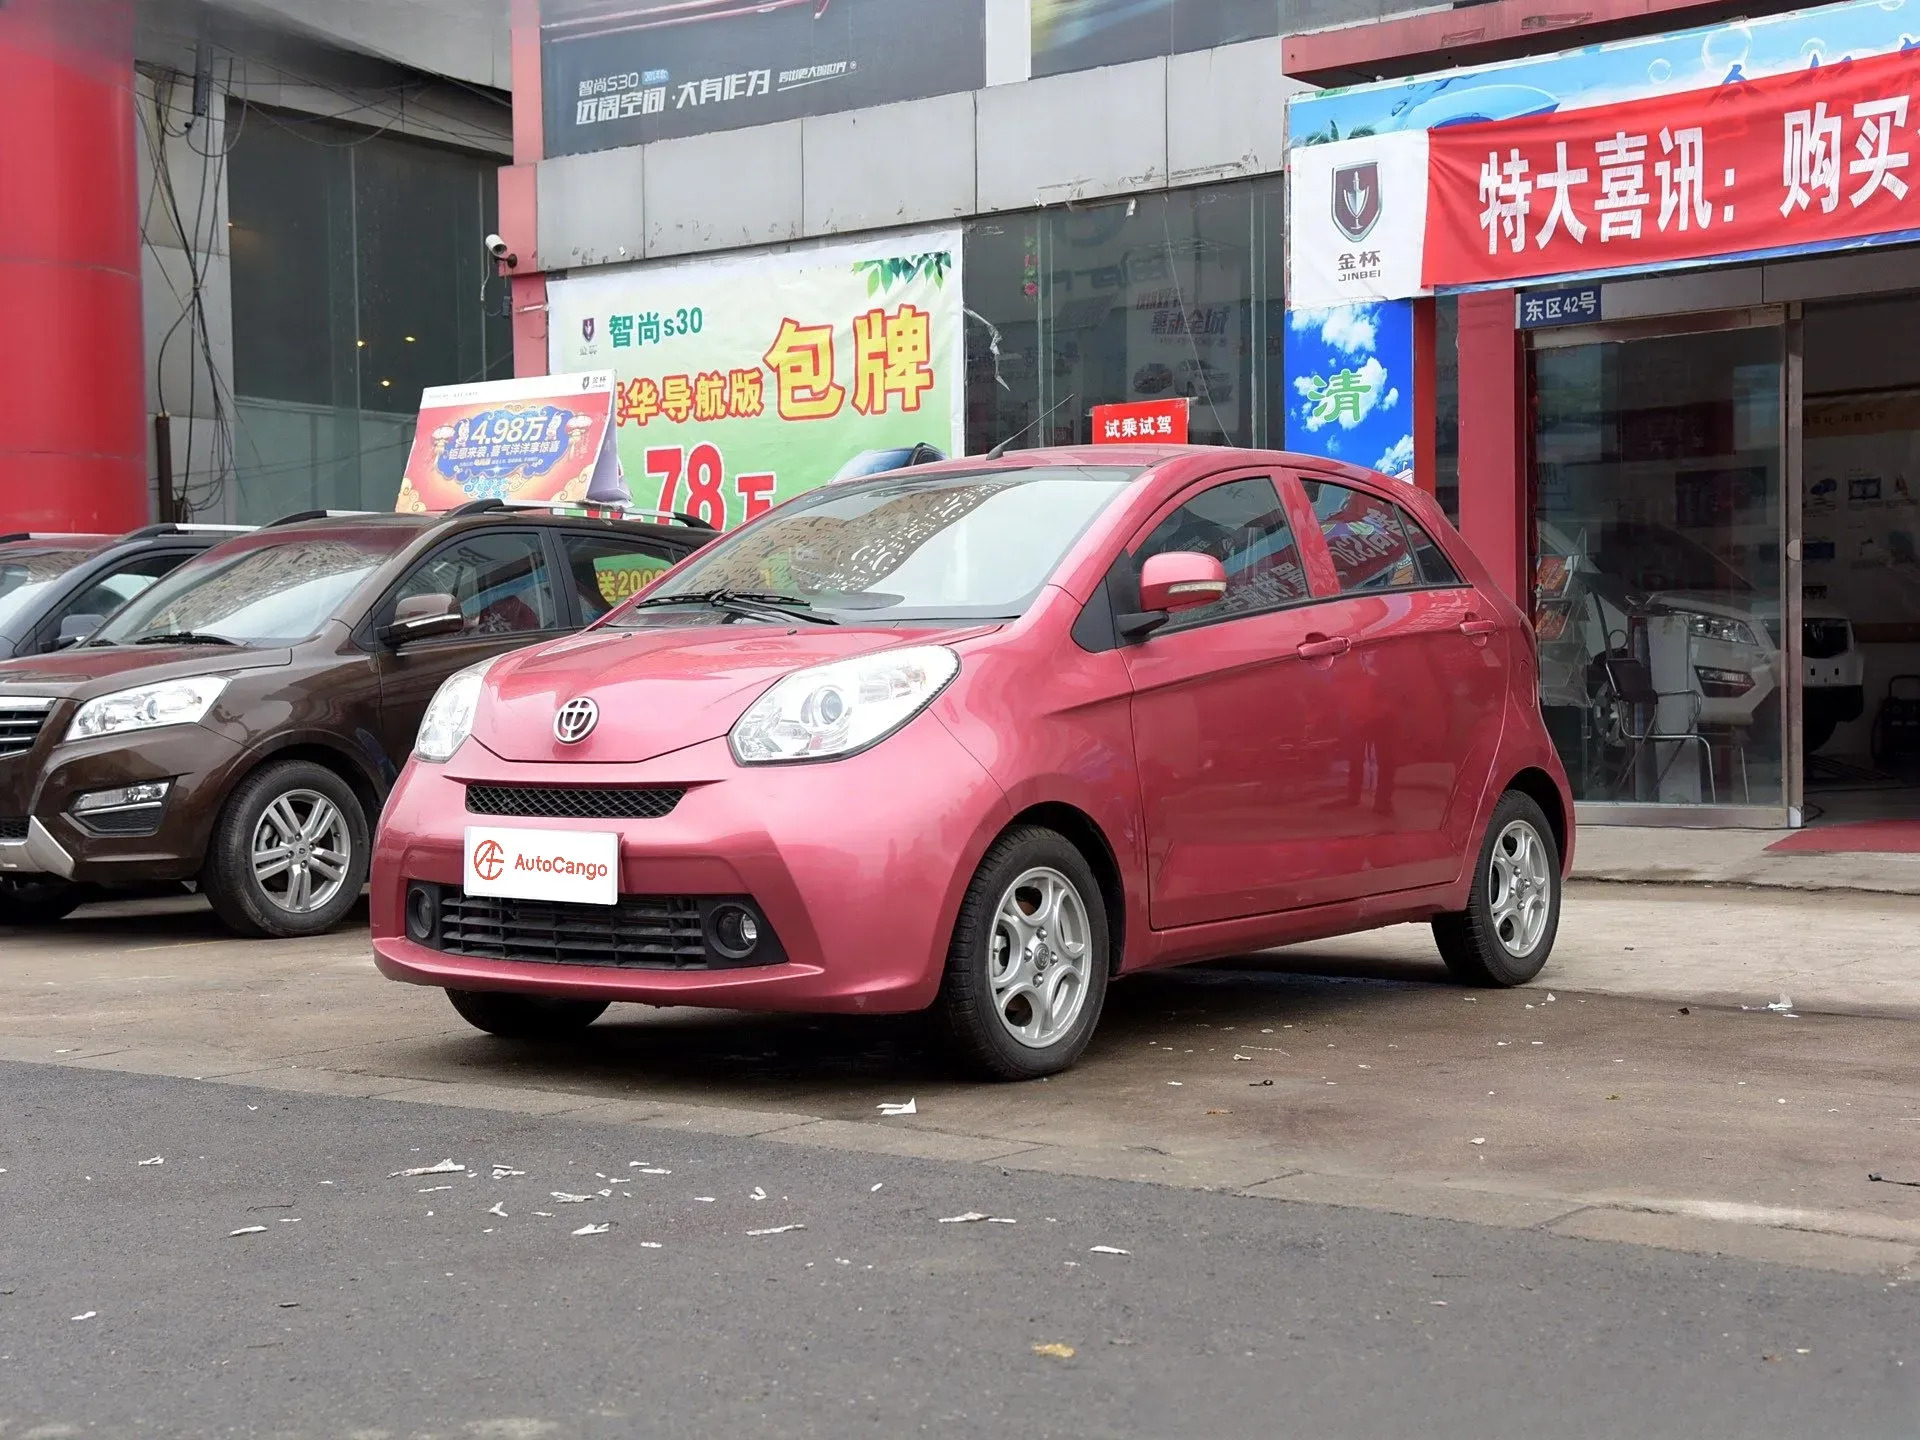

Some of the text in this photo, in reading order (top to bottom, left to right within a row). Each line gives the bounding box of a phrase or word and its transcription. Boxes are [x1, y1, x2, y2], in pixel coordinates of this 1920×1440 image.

[1780, 95, 1920, 218] 购买
[1338, 250, 1381, 271] 金杯
[1338, 269, 1381, 282] JINBEI
[1525, 291, 1597, 322] 东区42号
[609, 306, 702, 348] 智尚s30
[617, 303, 933, 428] 华导航版 包牌
[1307, 368, 1371, 423] 清
[471, 414, 548, 446] 4.98万
[1104, 415, 1172, 439] 试乘试驾
[596, 569, 668, 603] 送200
